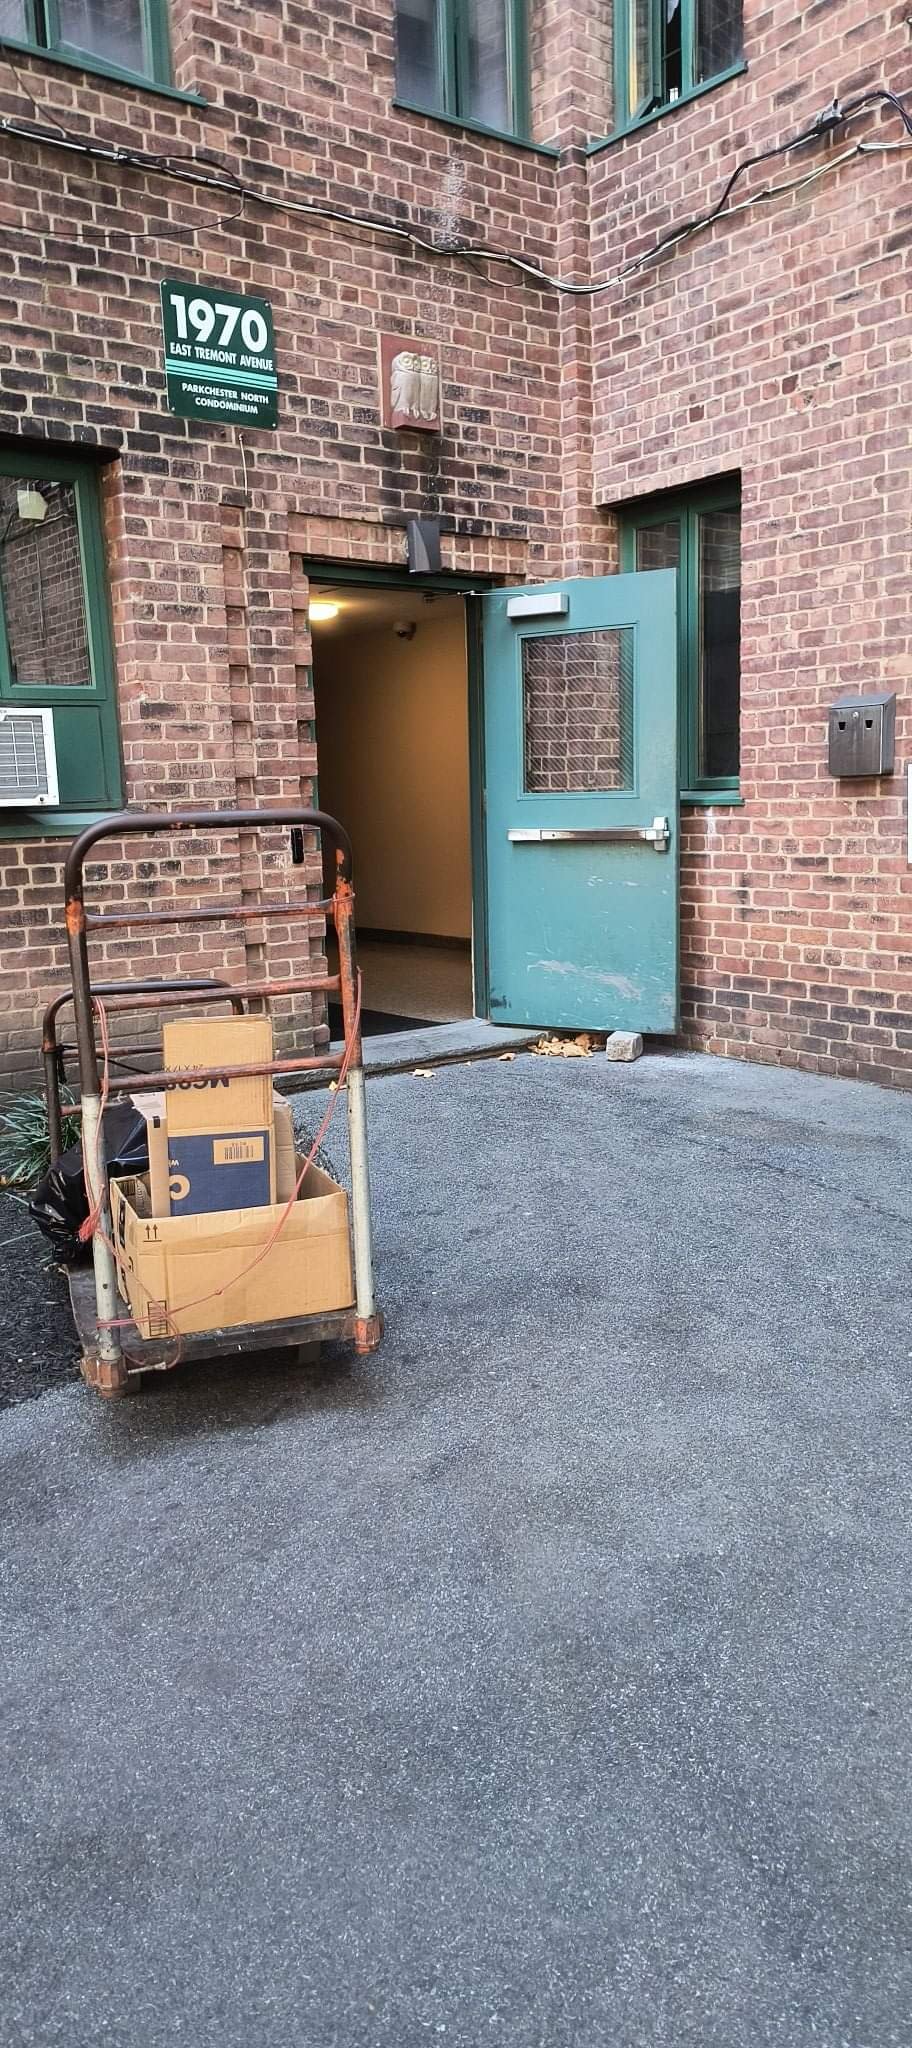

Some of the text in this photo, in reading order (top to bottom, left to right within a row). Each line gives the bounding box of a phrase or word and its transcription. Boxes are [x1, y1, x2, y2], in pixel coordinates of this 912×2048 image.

[170, 294, 268, 353] 1970
[170, 342, 273, 371] EAST TREMONT AVENUE
[181, 382, 269, 404] PARKCHESTER NORTH
[195, 397, 258, 414] CONDOMINIUM
